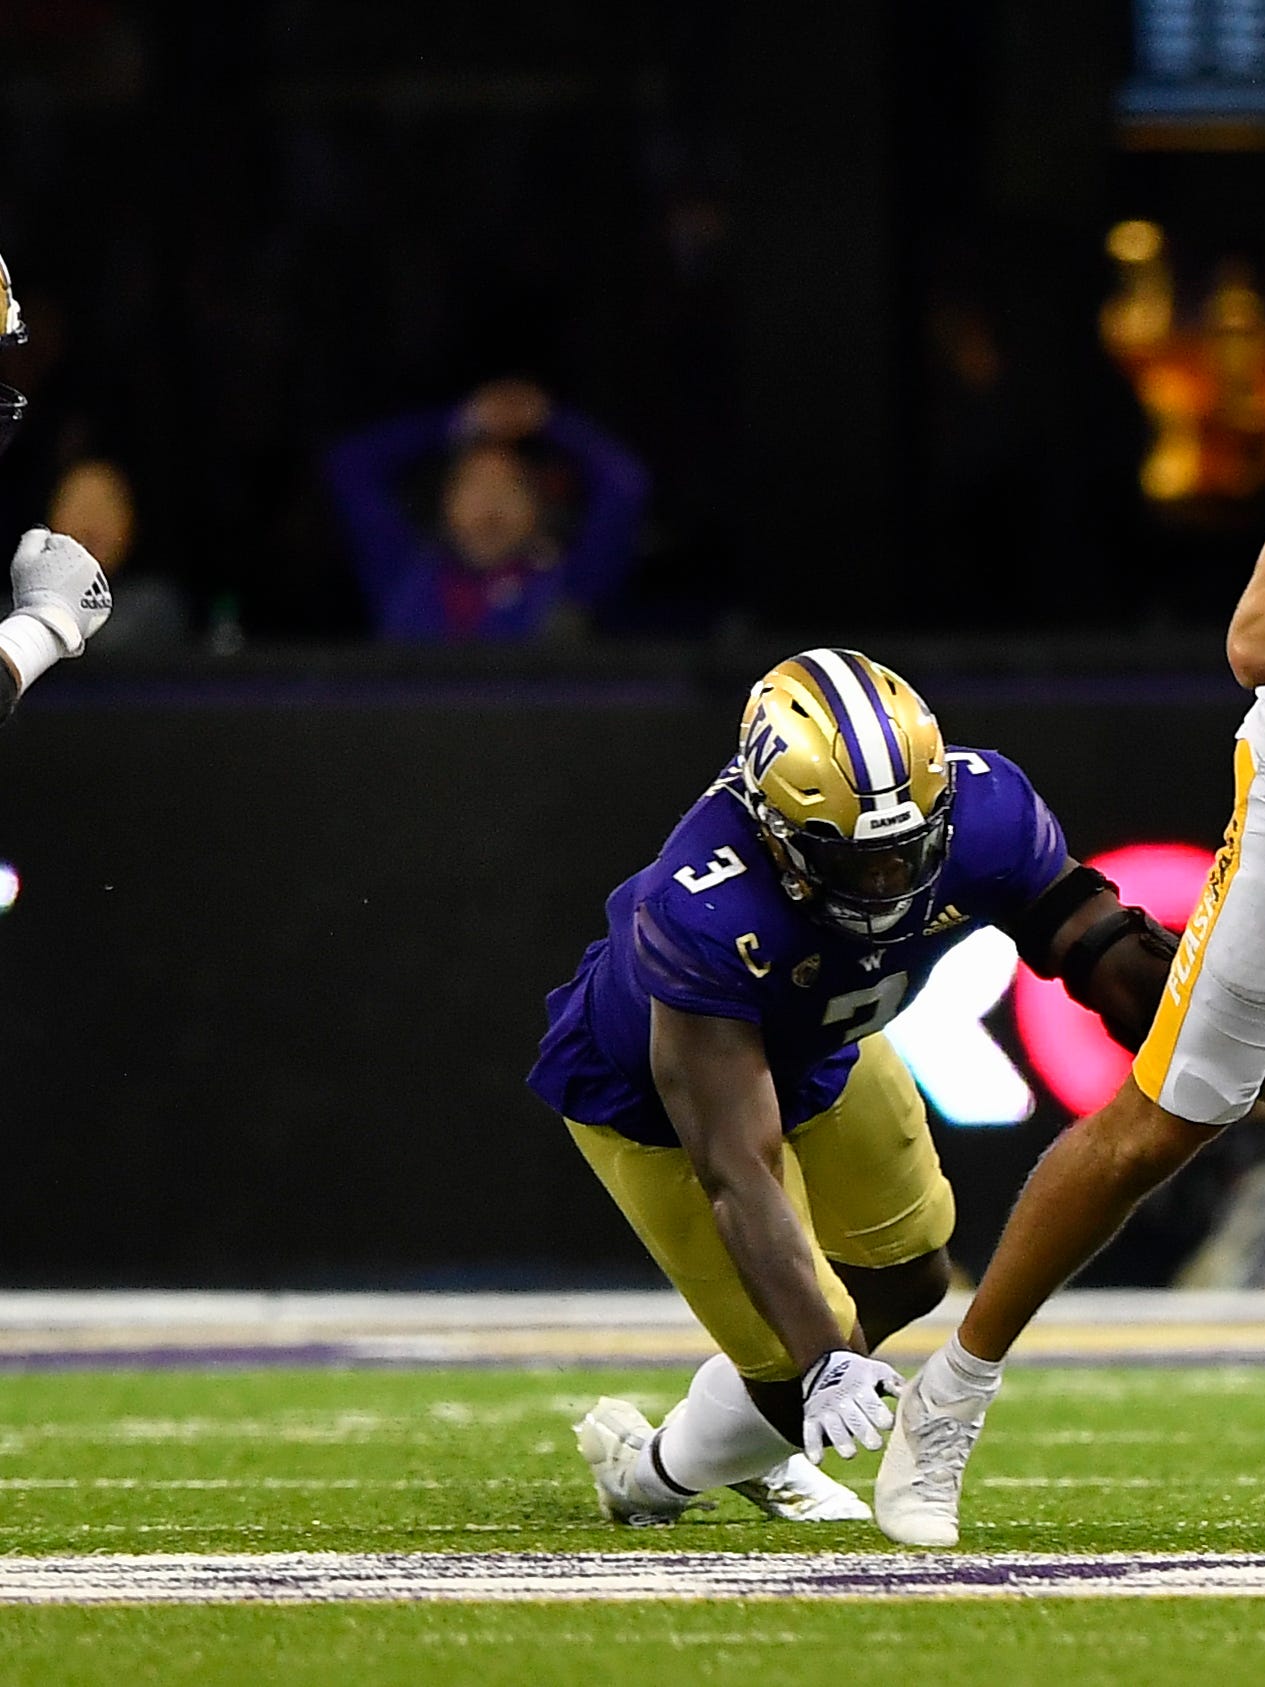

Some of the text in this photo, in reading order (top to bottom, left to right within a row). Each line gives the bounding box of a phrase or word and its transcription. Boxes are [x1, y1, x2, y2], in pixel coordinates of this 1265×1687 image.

[743, 703, 788, 783] W
[673, 846, 747, 894] 3
[735, 933, 771, 978] C
[859, 949, 887, 972] W
